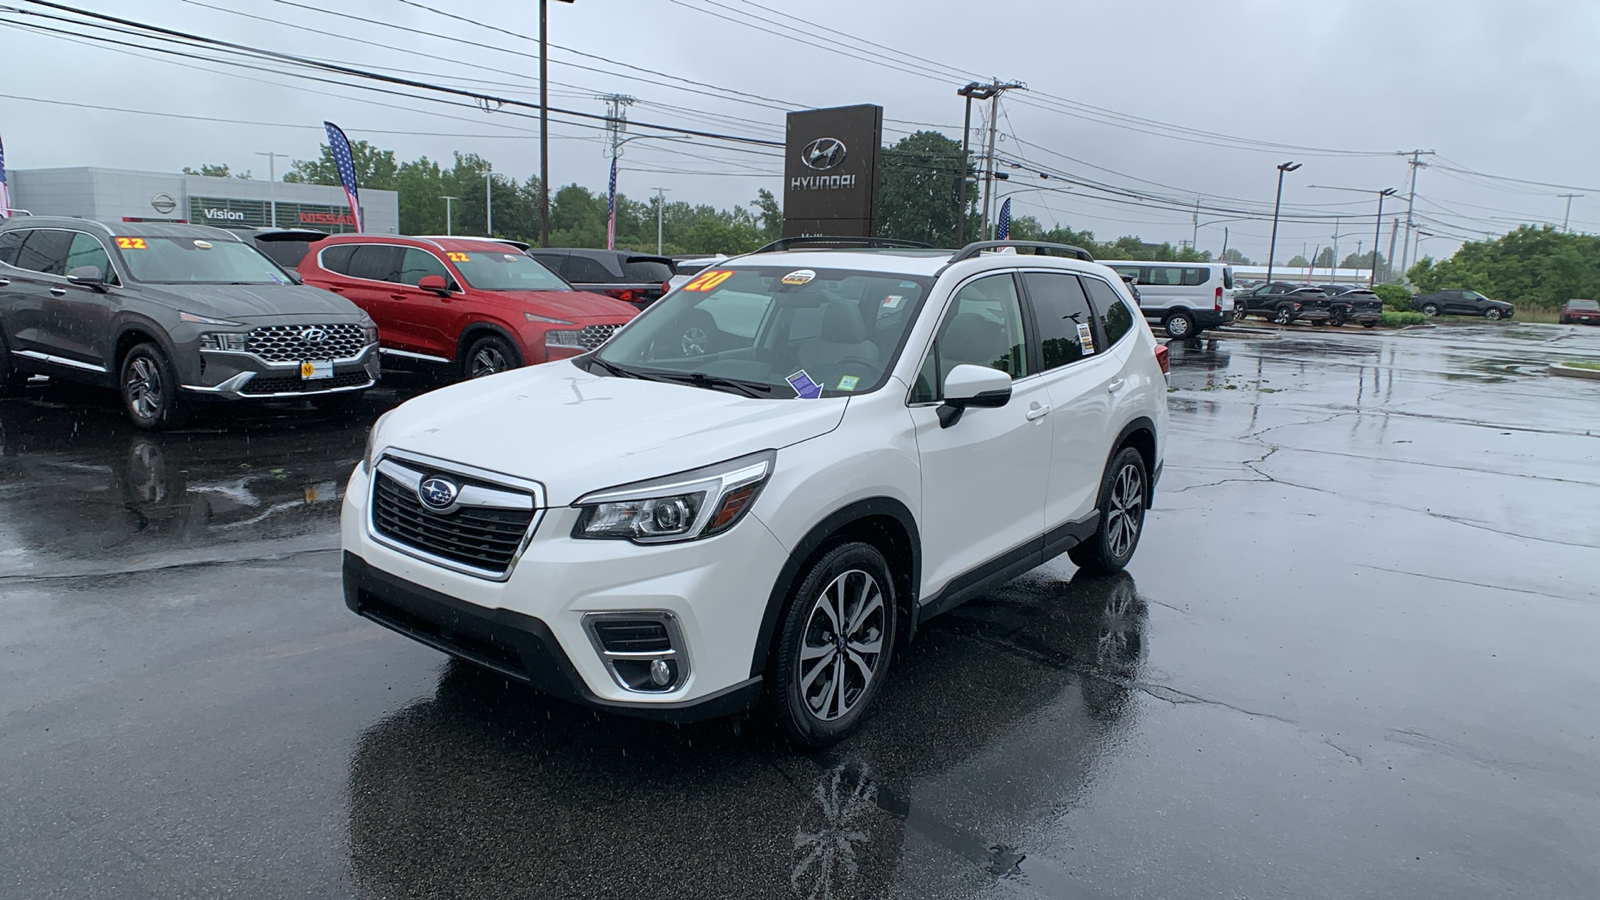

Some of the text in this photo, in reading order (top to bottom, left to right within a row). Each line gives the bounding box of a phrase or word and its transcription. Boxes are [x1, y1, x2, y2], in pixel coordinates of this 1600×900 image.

[791, 175, 855, 190] HYUNDAI
[204, 208, 244, 220] Vision
[117, 238, 147, 249] 22
[446, 252, 470, 262] 22
[684, 271, 732, 291] 20
